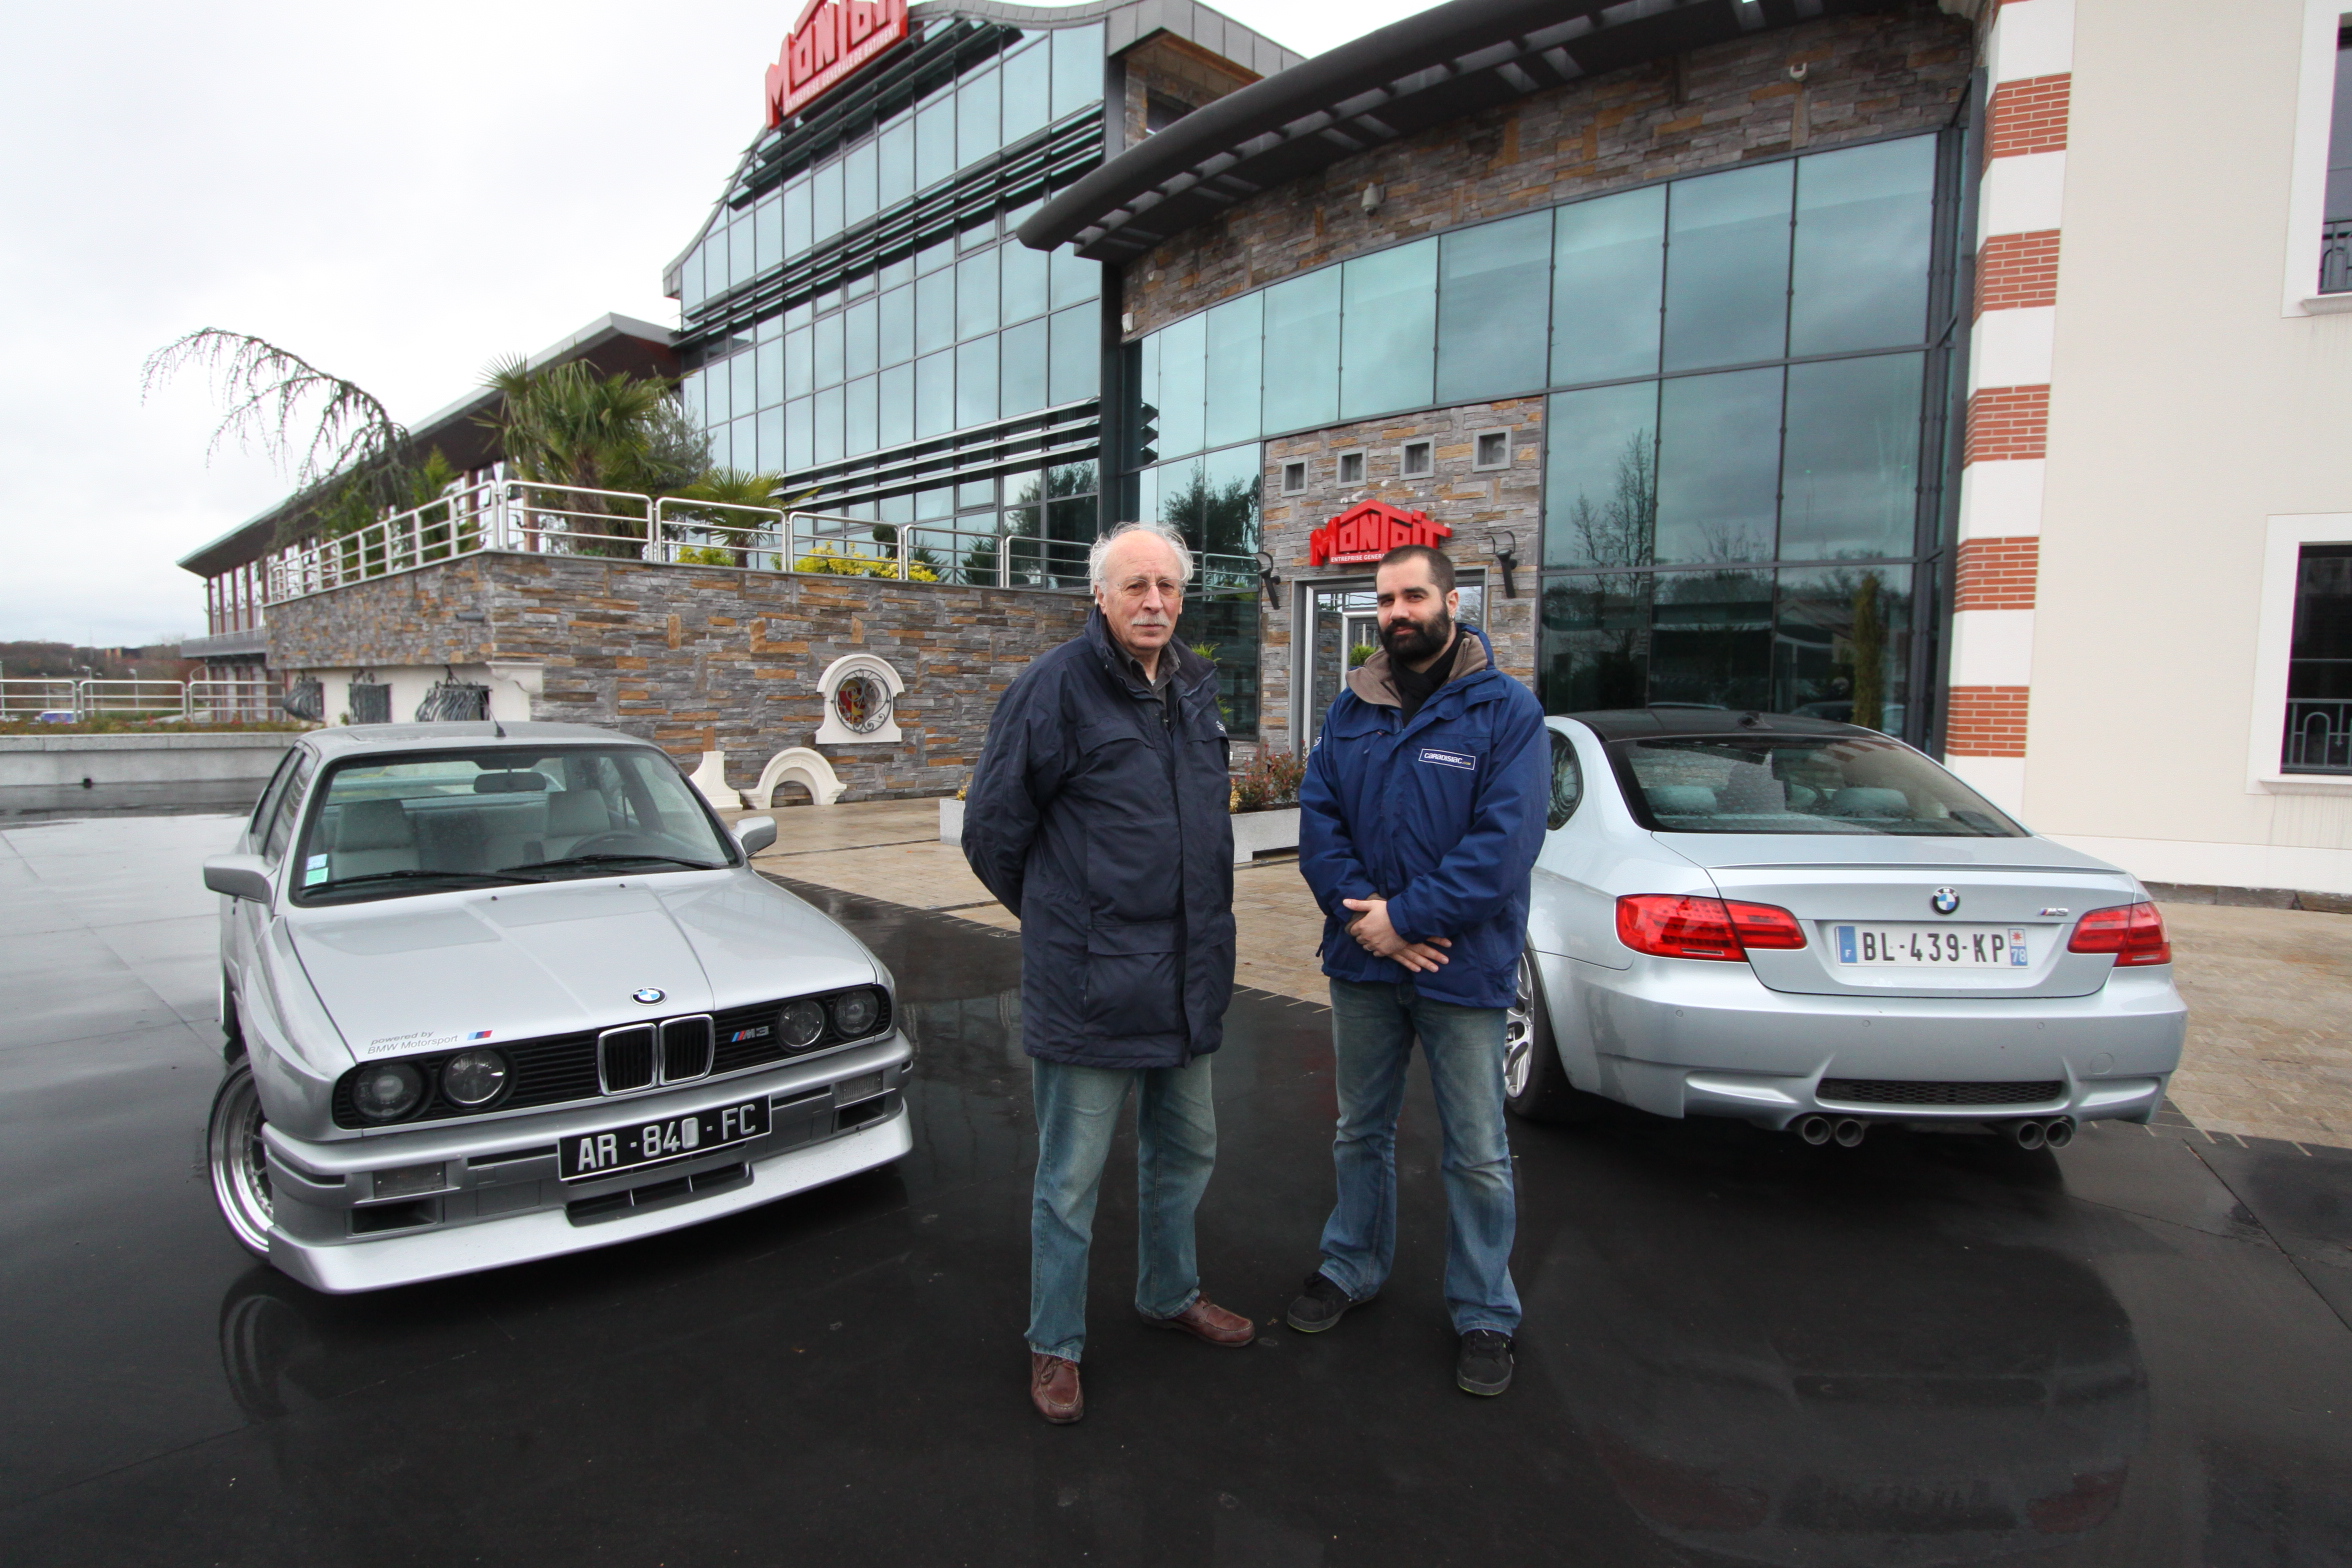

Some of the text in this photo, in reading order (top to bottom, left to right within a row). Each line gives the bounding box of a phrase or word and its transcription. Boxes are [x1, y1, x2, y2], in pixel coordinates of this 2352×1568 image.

[1330, 554, 1363, 563] ENTREPRISE
[2011, 948, 2027, 963] 78
[370, 1030, 434, 1046] powered by
[743, 1026, 770, 1040] M3
[367, 1035, 458, 1055] BMW Motorsport
